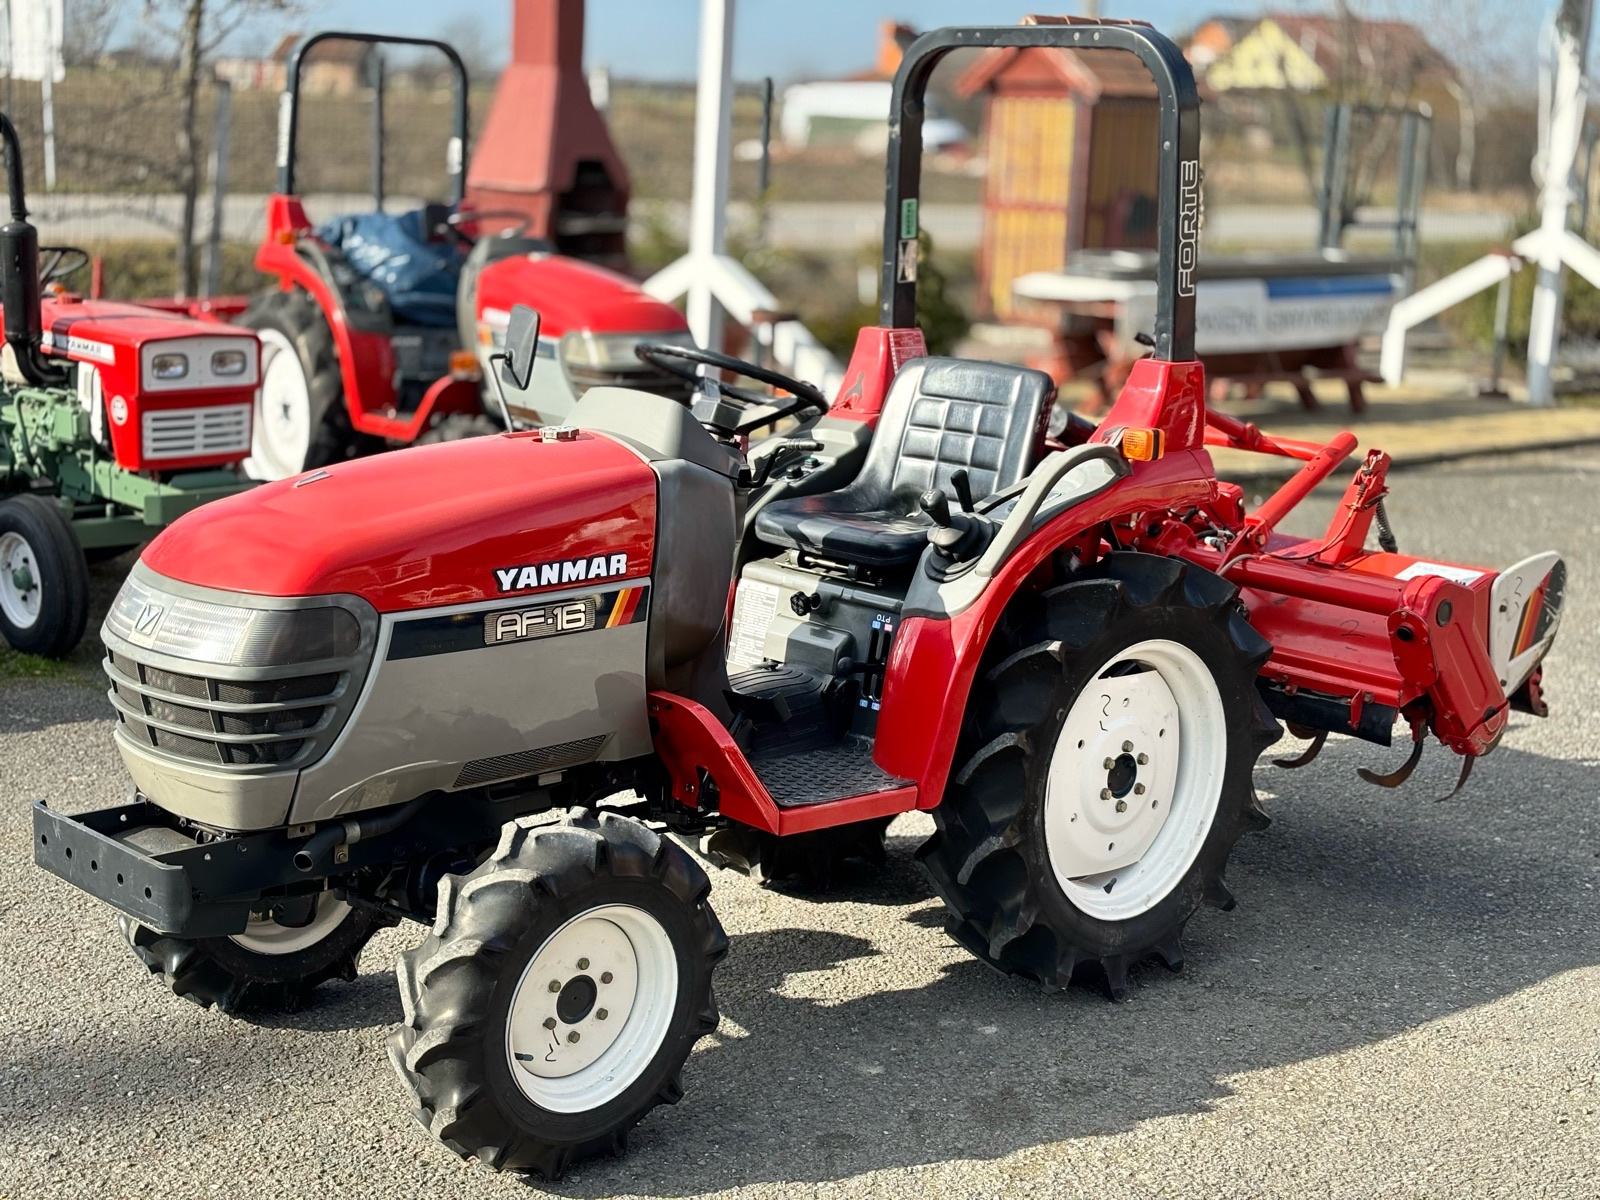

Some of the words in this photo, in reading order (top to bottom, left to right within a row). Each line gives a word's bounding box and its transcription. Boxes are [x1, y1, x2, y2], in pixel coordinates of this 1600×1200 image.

[1178, 160, 1198, 297] FORTE
[496, 553, 627, 590] YANMAR
[876, 614, 891, 624] PTO
